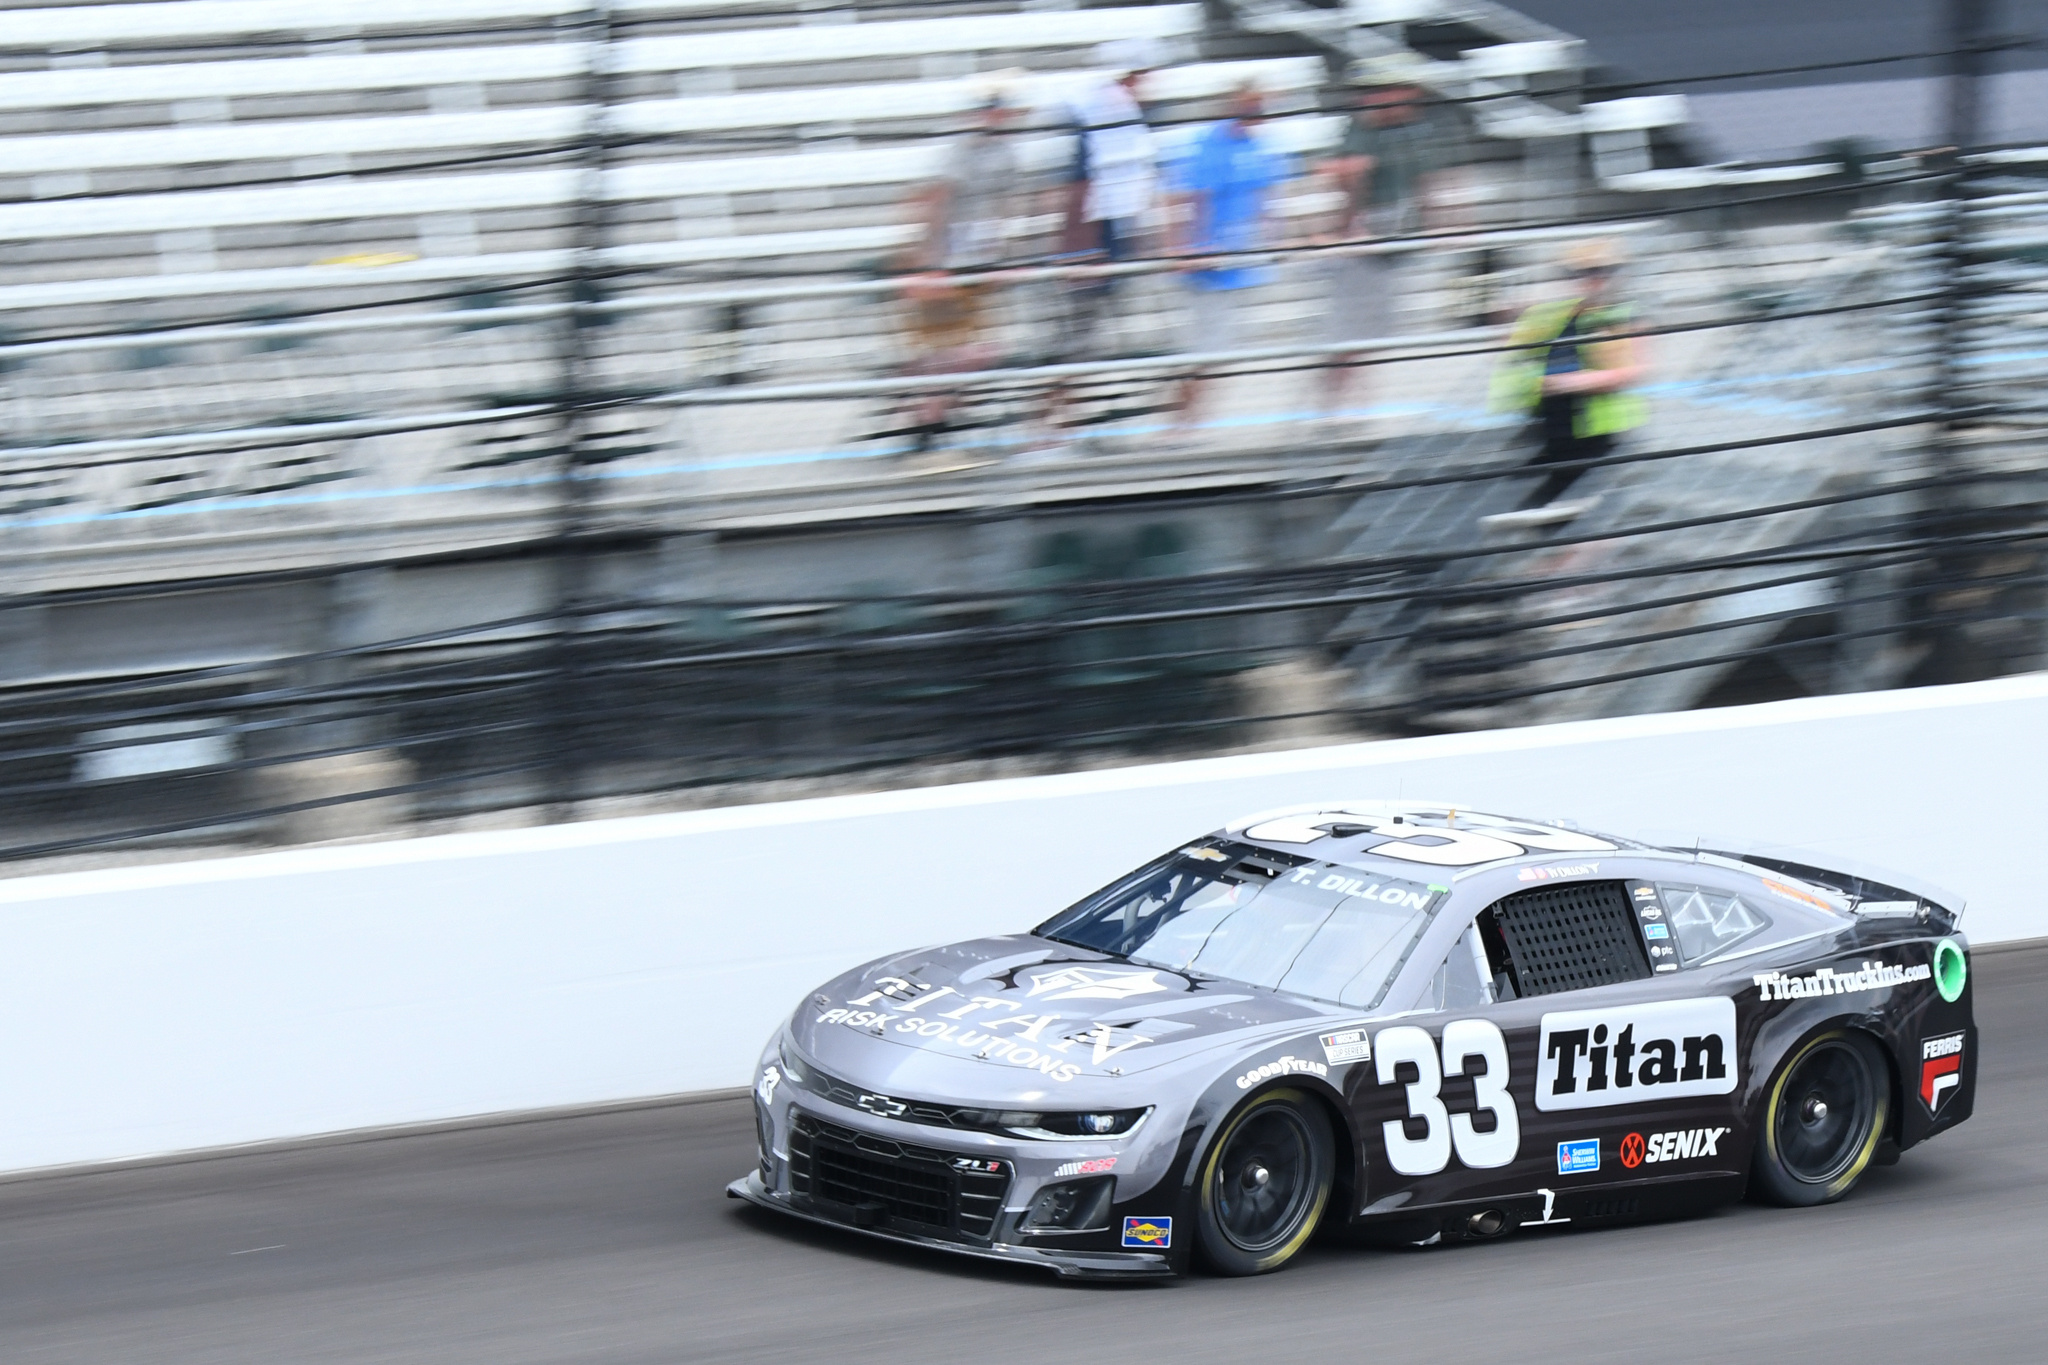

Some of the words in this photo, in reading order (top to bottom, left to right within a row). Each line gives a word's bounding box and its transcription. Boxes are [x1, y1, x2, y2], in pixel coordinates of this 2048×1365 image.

[1290, 866, 1312, 886] T.
[1315, 873, 1432, 910] DILLON
[1753, 961, 1931, 1001] TitanTruckIns.com
[847, 976, 1153, 1065] TITAN
[817, 1008, 898, 1029] RISK
[895, 1017, 1081, 1082] SOLUTIONS
[1344, 1046, 1364, 1056] SERIES
[1547, 1023, 1726, 1096] Titan
[1923, 1034, 1964, 1059] FERRIS
[1236, 1056, 1328, 1089] GOODYEAR
[1374, 1019, 1520, 1176] 33
[1645, 1127, 1726, 1163] SENIX
[952, 1157, 1000, 1172] ZL1
[1126, 1228, 1168, 1237] SUNOCO
